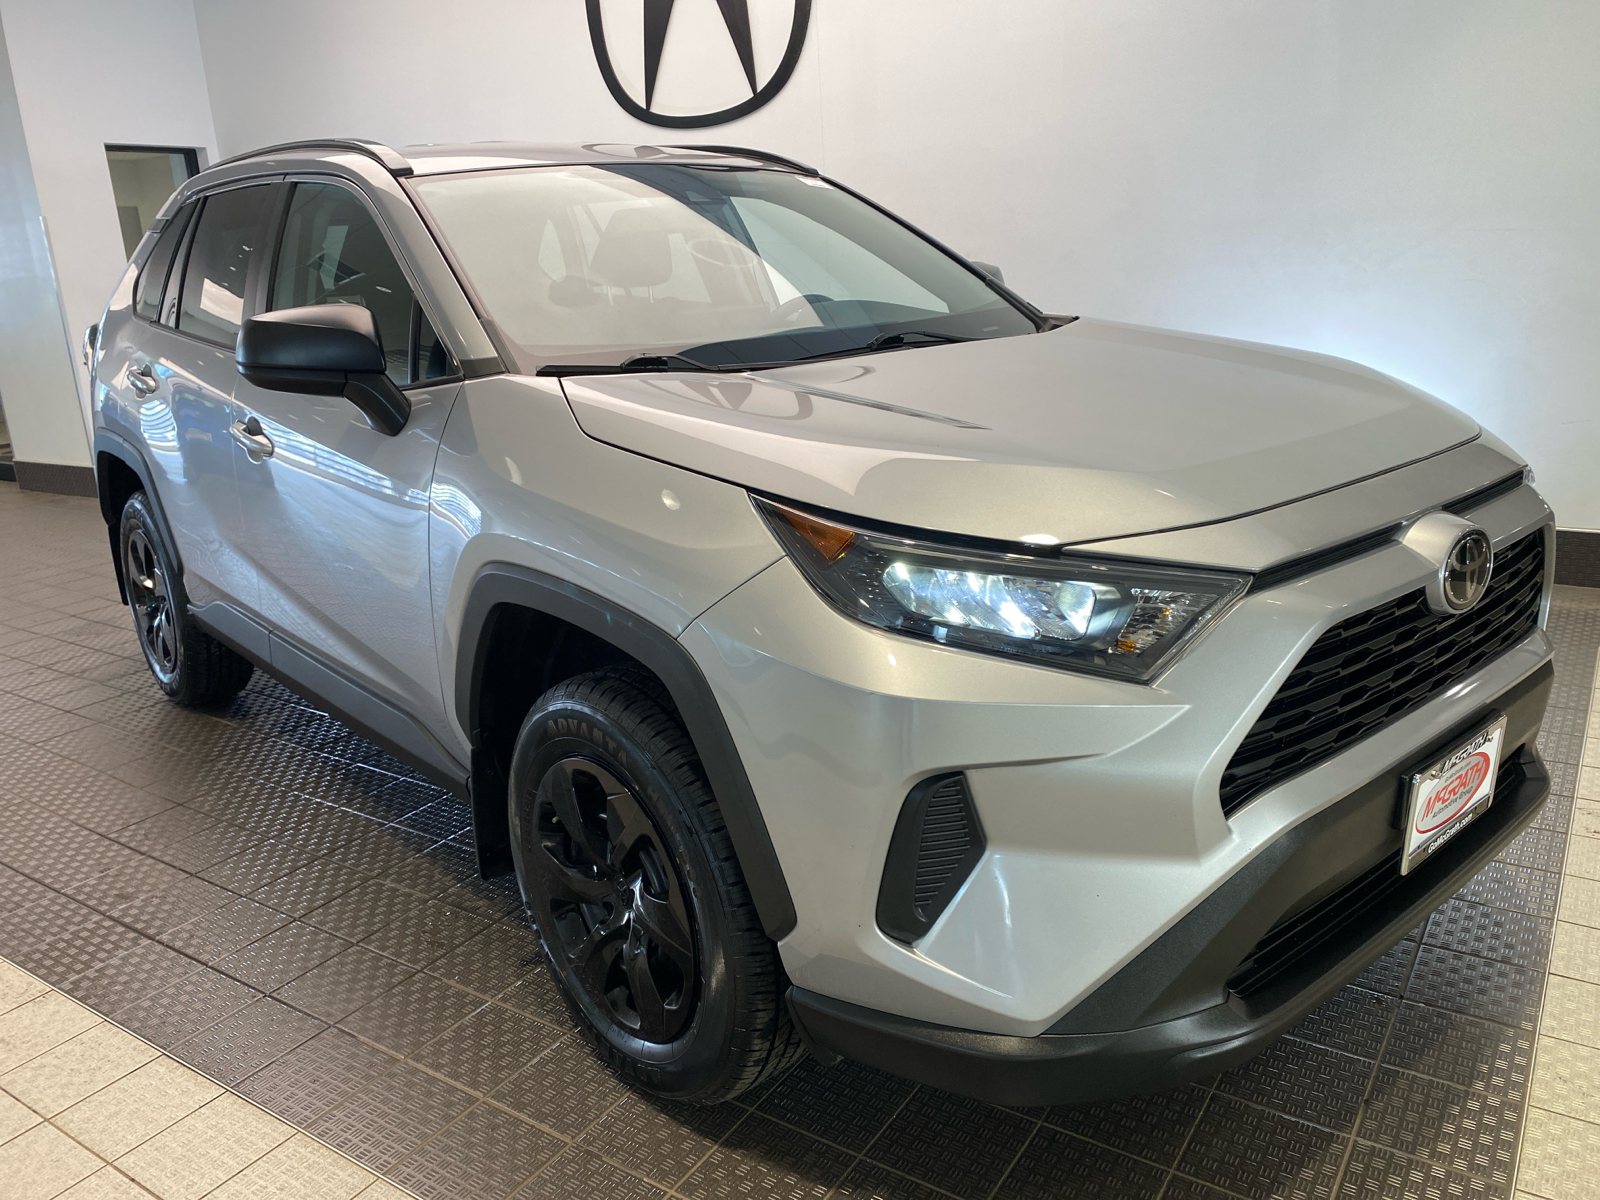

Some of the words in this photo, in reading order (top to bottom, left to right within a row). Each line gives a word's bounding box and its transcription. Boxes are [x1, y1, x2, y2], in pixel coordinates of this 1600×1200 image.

[546, 718, 628, 770] ADVANTA
[1431, 795, 1459, 820] Automotive
[1459, 785, 1474, 800] Group
